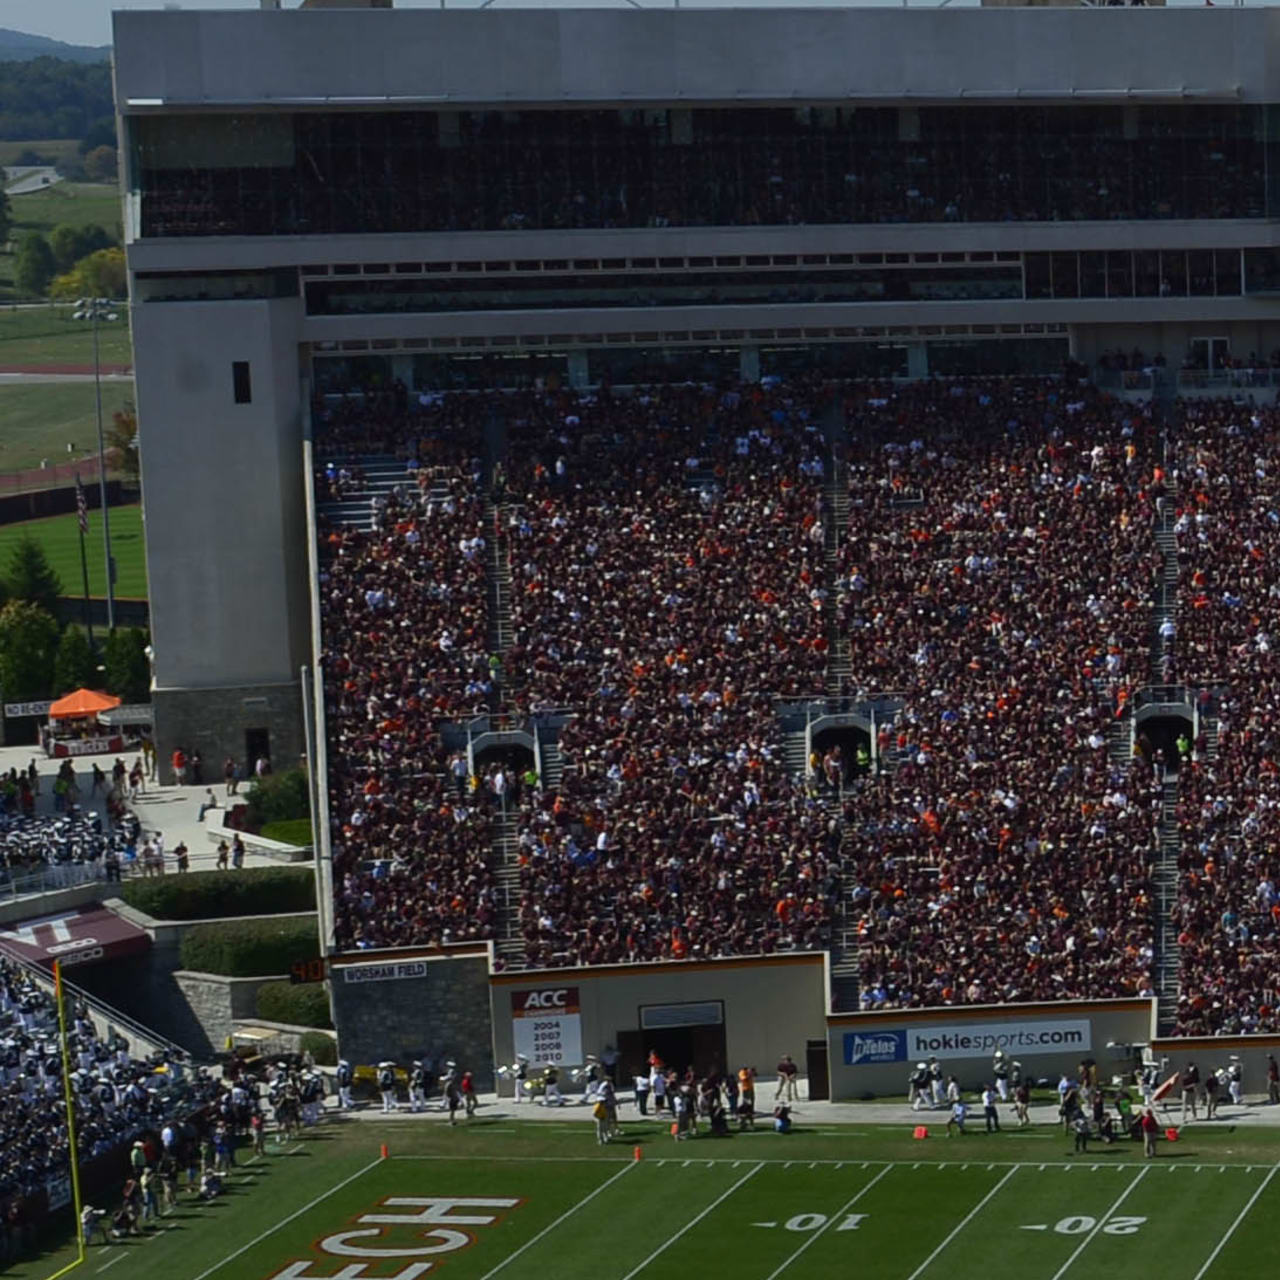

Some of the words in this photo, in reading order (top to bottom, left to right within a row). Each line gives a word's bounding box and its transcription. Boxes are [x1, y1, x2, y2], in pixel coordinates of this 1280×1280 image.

[399, 963, 426, 978] FIELD
[524, 989, 569, 1009] ACC
[533, 1021, 560, 1031] 2004
[533, 1031, 561, 1042] 2007
[915, 1028, 1083, 1053] hokiesports.com
[535, 1052, 562, 1062] 2010
